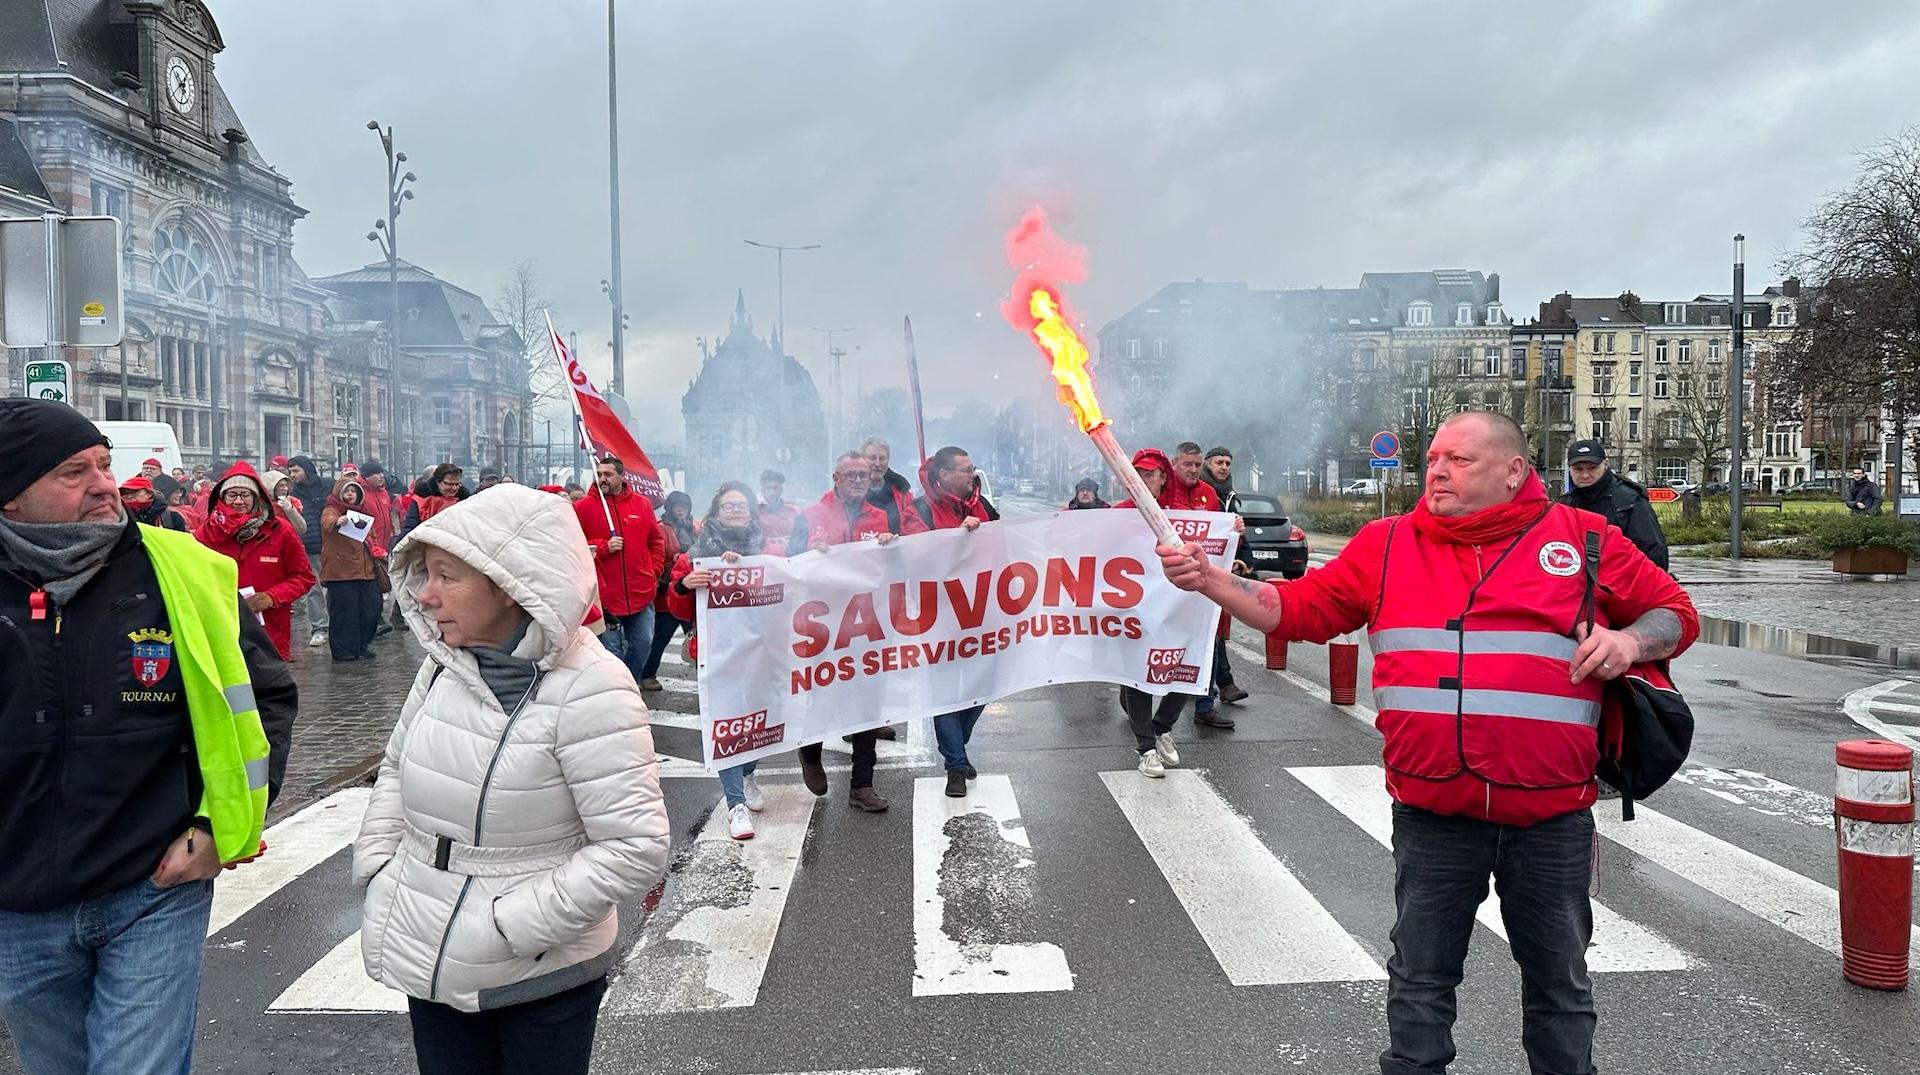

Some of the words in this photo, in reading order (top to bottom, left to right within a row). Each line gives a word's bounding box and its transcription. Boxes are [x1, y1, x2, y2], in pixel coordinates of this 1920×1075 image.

[29, 367, 40, 377] 41
[41, 390, 54, 400] 40
[1171, 520, 1208, 537] GSP
[709, 568, 762, 587] CGSP
[749, 594, 781, 606] picarde
[792, 556, 1145, 658] SAUVONS
[791, 656, 856, 695] NOS
[862, 627, 1011, 676] SERVICES
[1015, 615, 1143, 644] PUBLICS
[121, 691, 177, 702] TOURNAI
[715, 712, 765, 738] CGSP
[752, 735, 782, 749] picarde
